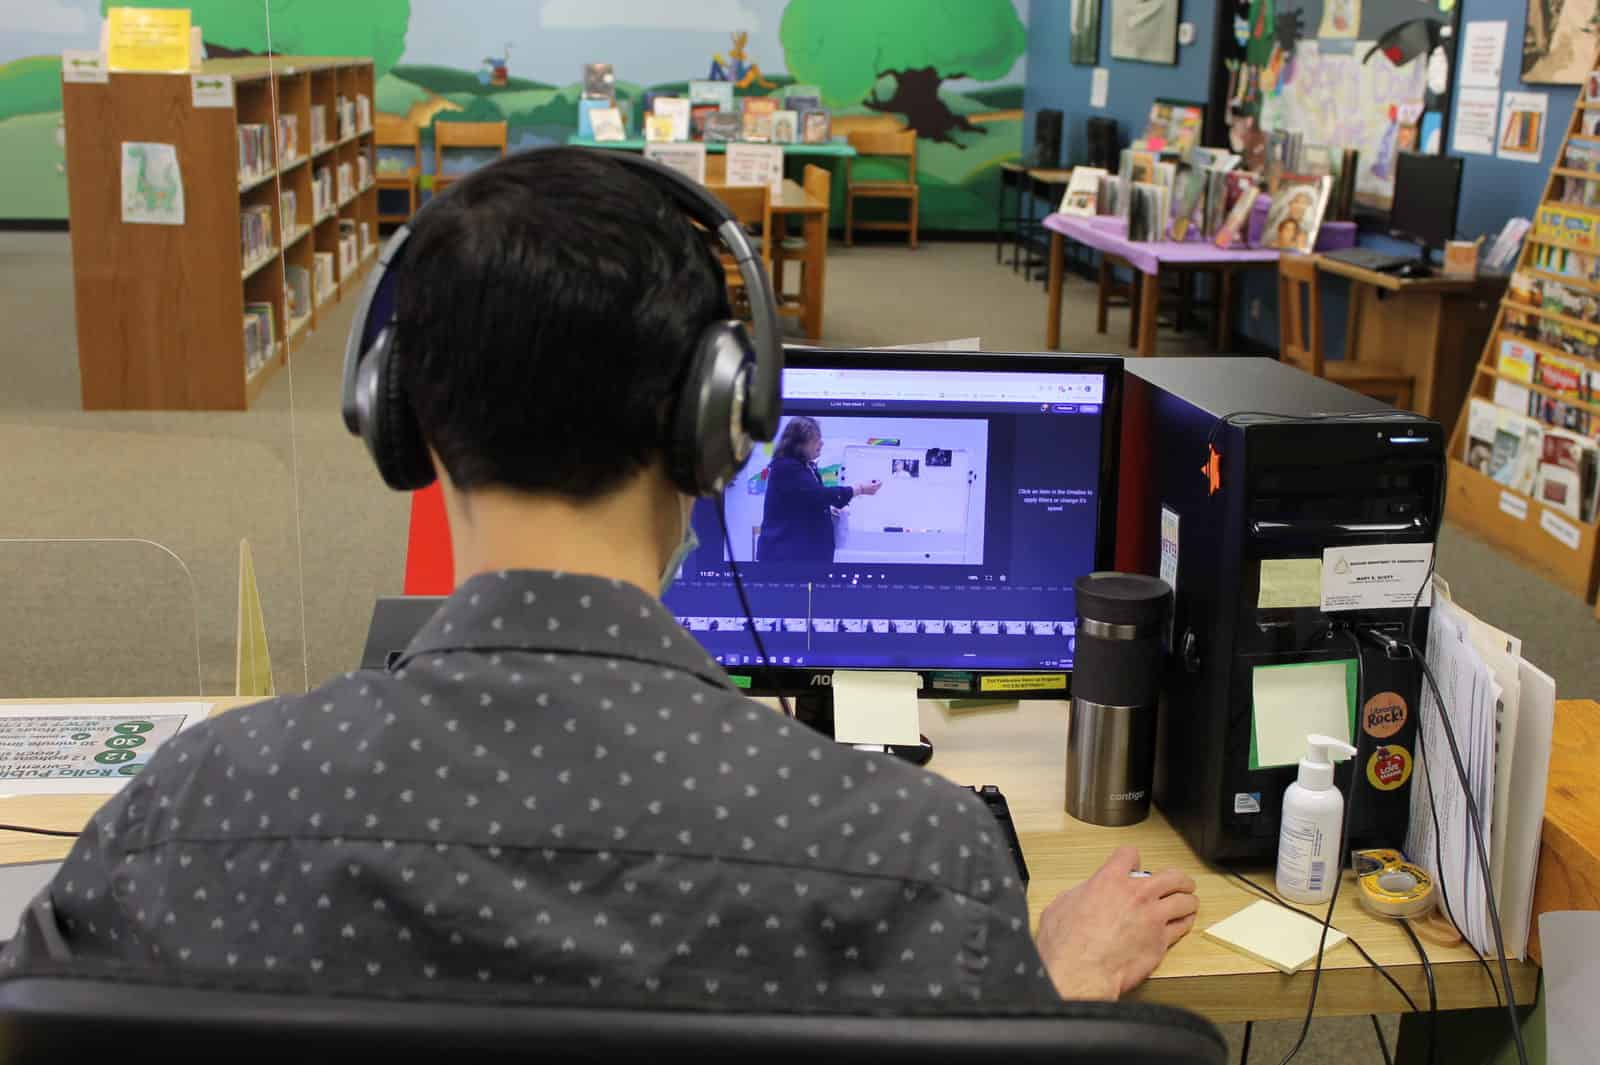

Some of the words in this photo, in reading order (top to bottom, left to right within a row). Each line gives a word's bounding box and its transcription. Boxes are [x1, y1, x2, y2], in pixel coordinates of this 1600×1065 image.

[810, 675, 834, 686] AO
[1368, 708, 1404, 728] Rock!
[112, 738, 138, 746] 30
[104, 753, 128, 761] 12
[60, 769, 113, 777] Rolla
[1110, 790, 1145, 801] contigo
